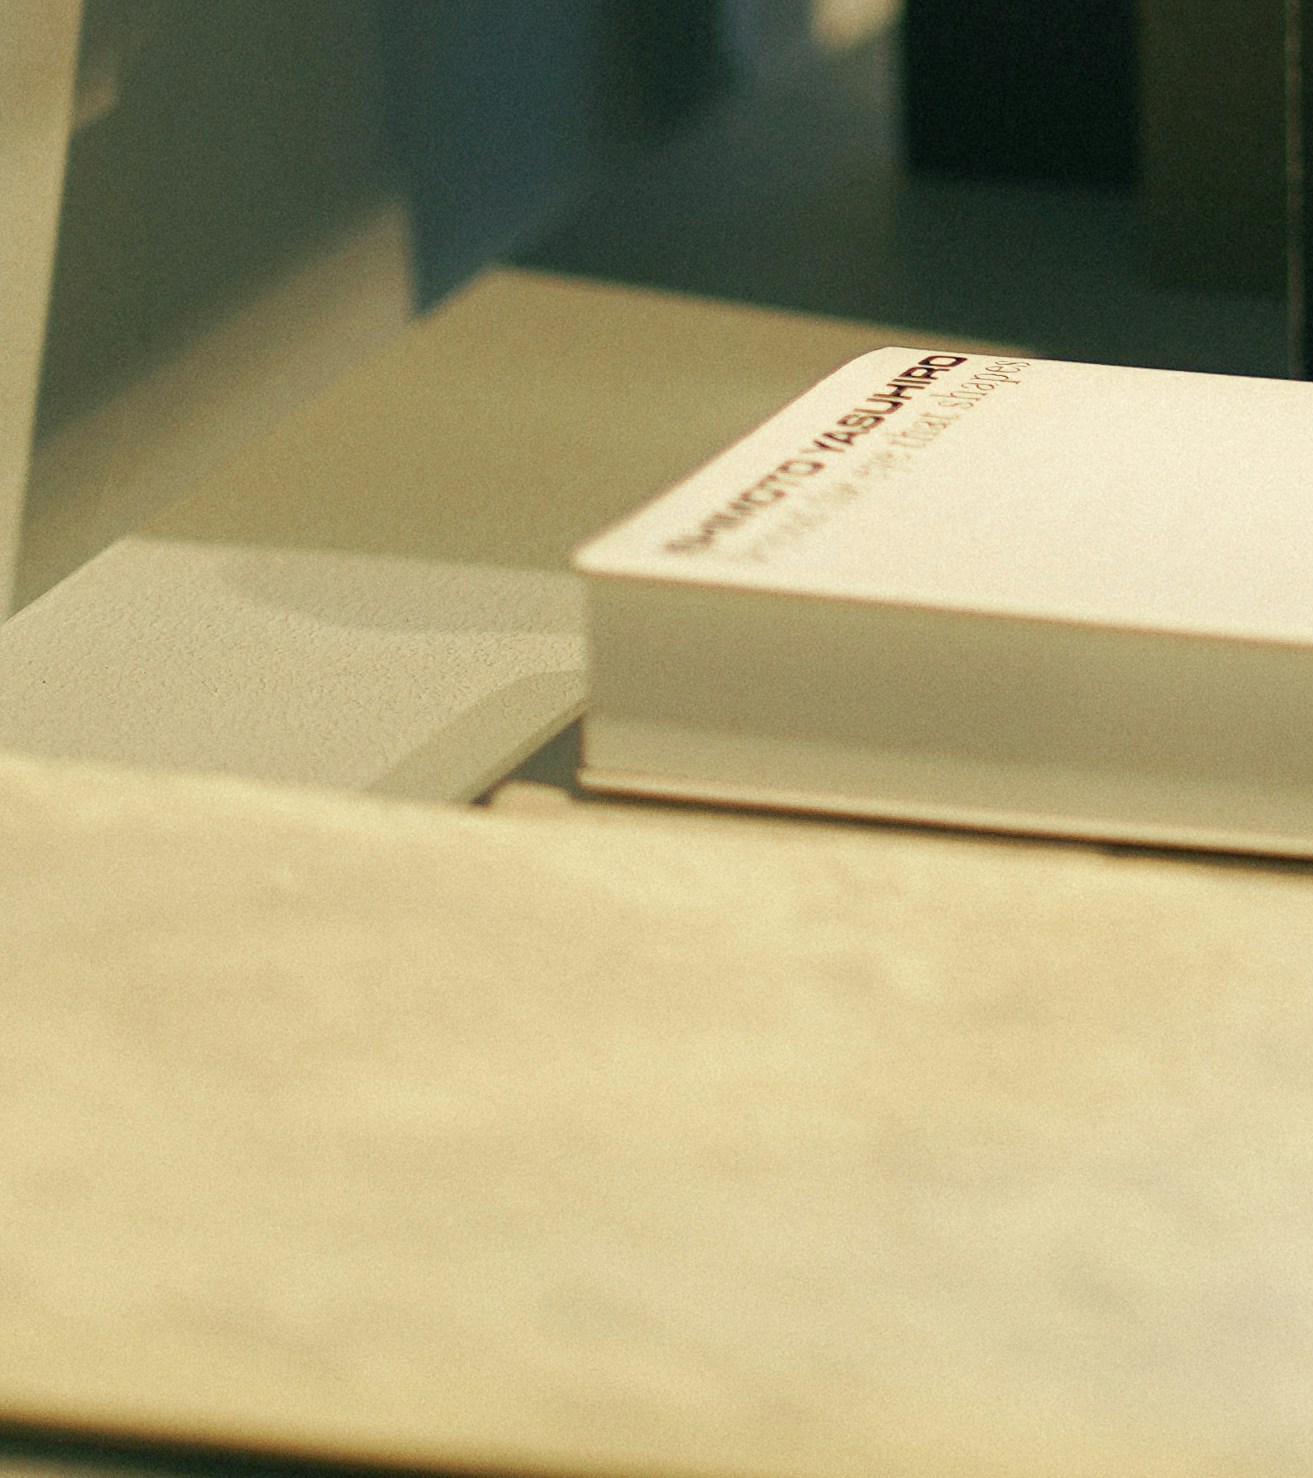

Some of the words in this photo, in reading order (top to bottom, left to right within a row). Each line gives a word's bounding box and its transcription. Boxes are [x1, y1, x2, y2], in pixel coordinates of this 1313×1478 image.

[799, 354, 968, 454] YASUHIRO
[880, 410, 960, 449] that
[929, 359, 1031, 410] shapes
